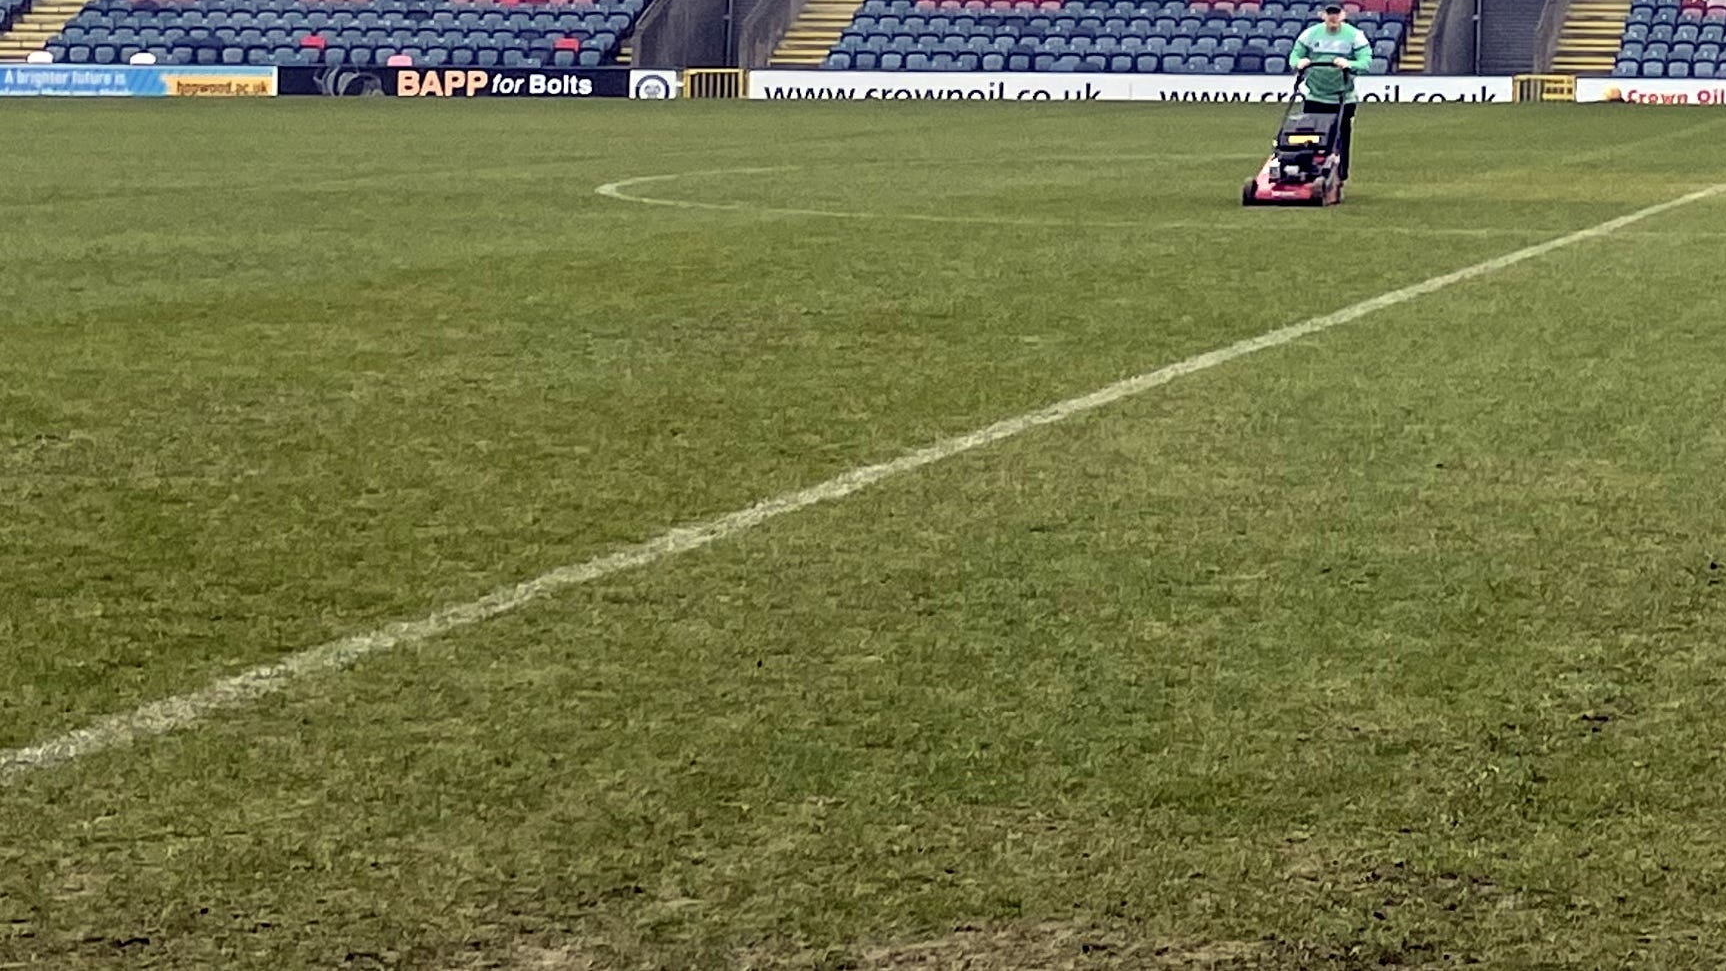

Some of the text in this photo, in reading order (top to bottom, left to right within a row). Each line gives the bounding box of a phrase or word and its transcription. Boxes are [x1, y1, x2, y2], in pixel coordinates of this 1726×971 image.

[398, 70, 592, 96] BAPP for Bolts
[764, 82, 1101, 100] wwwcrownoilcouk
[1159, 86, 1497, 102] wwwcrooilcouk
[1627, 89, 1726, 105] Crown Oil
